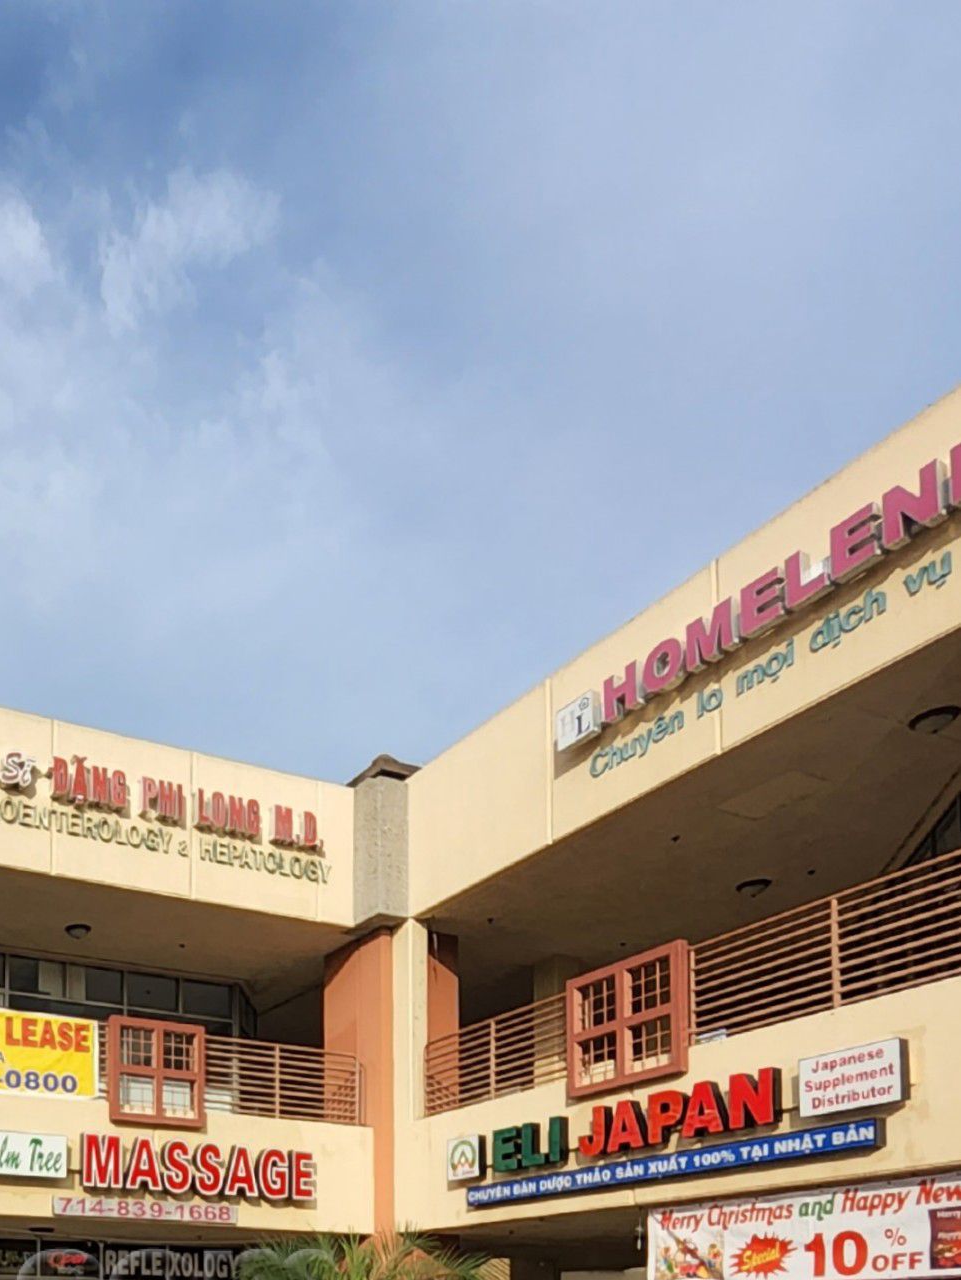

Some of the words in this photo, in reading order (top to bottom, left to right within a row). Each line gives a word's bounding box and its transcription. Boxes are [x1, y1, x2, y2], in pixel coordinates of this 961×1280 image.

[140, 775, 185, 817] PHI
[196, 787, 261, 837] LONG
[199, 836, 333, 884] HEPATOLOGY
[4, 1016, 91, 1054] LEASE
[804, 1063, 895, 1093] Supplement
[811, 1047, 885, 1073] Japanese
[811, 1084, 894, 1109] Distributor
[492, 1115, 569, 1172] ELI
[578, 1067, 775, 1158] JAPAN
[28, 1137, 64, 1174] Tree
[82, 1132, 314, 1199] MASSAGE
[693, 1149, 736, 1168] 100%
[58, 1197, 232, 1222] 714-839-1668
[660, 1208, 704, 1233] Merry
[707, 1200, 794, 1230] Christmas
[798, 1190, 837, 1221] and
[841, 1187, 912, 1217] Happy
[741, 1242, 781, 1272] Special
[804, 1230, 868, 1277] 10
[871, 1252, 924, 1272] OFF
